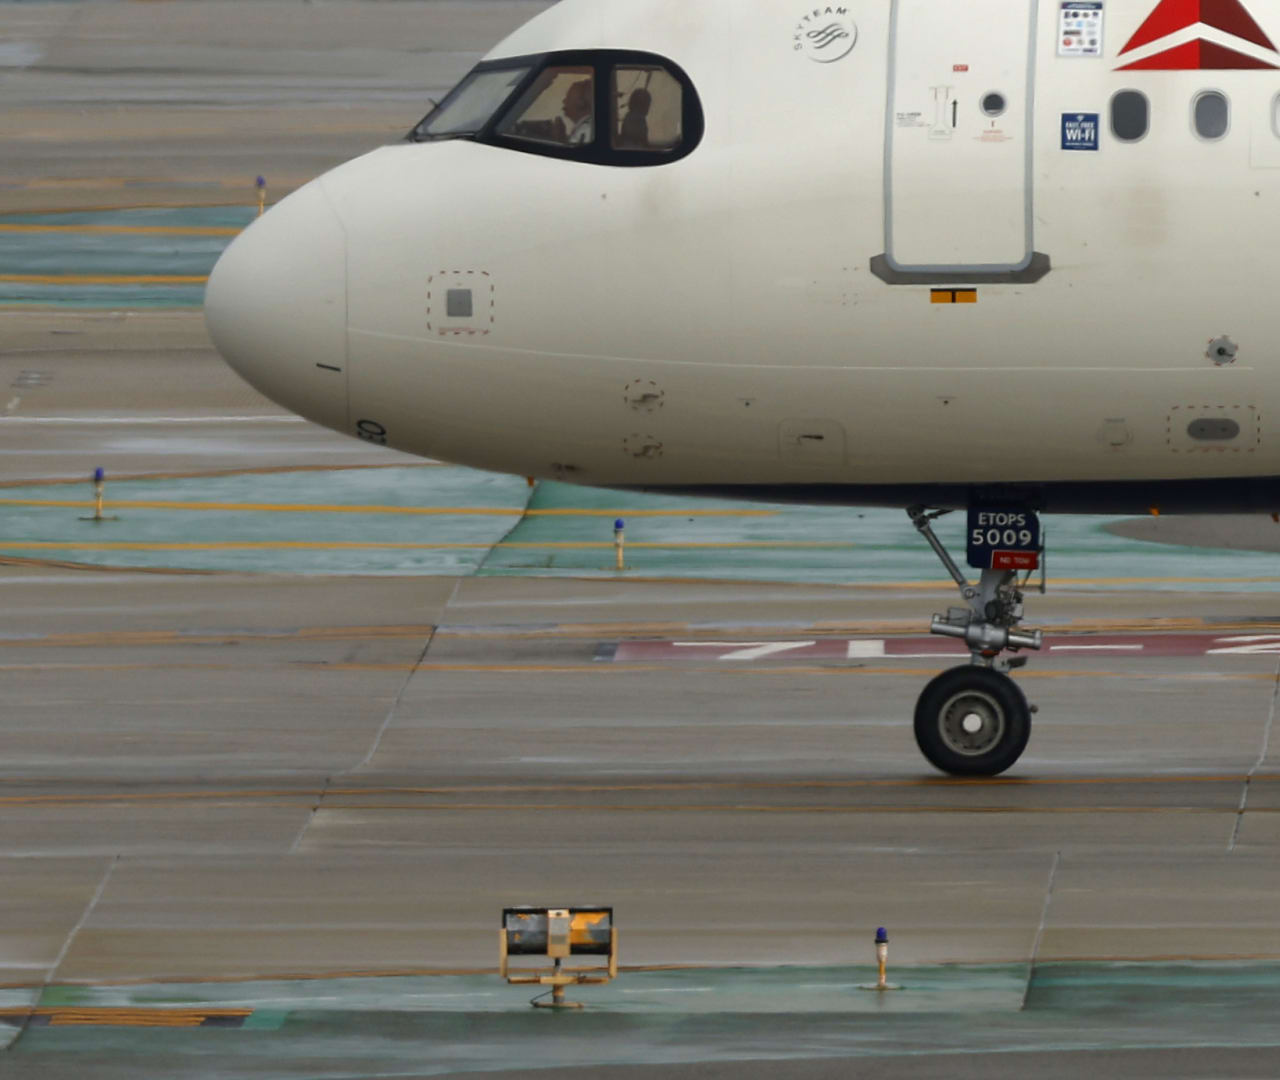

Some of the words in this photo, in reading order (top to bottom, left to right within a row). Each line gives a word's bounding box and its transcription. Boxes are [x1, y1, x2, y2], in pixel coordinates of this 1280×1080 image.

[793, 6, 848, 52] SKYTEAM
[978, 512, 1026, 526] ETOPS
[972, 528, 1032, 546] 5009
